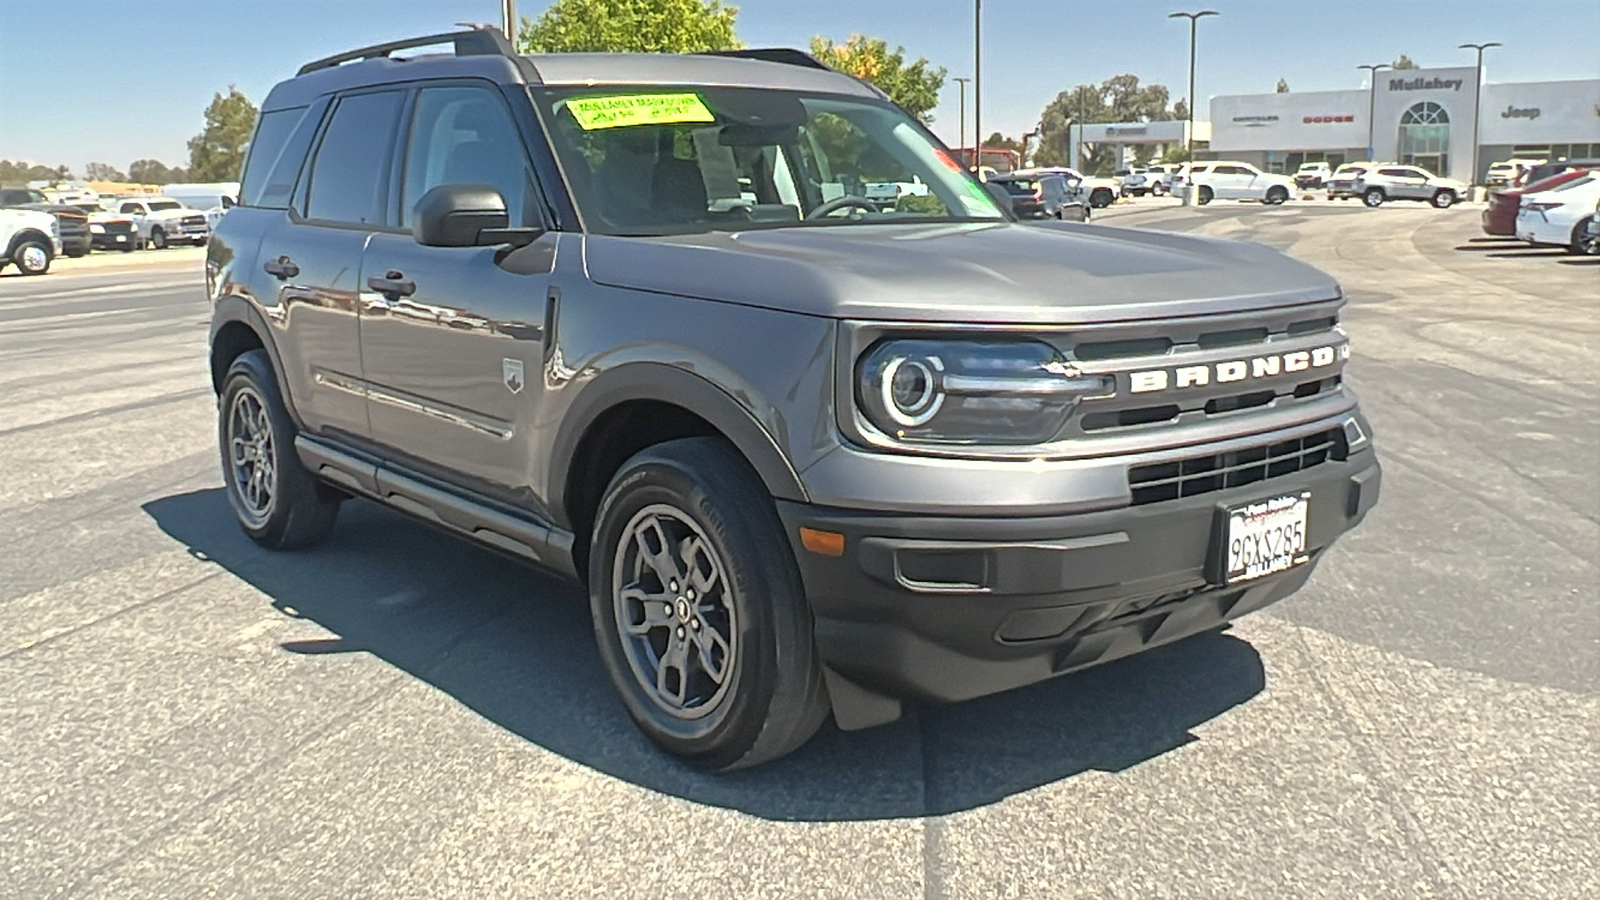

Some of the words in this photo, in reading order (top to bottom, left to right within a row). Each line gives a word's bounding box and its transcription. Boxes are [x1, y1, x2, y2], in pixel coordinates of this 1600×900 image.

[1389, 77, 1463, 92] Mullahey
[1303, 115, 1354, 124] DODGE
[1501, 105, 1541, 120] Jeep
[1130, 346, 1334, 393] BRONCO
[1231, 520, 1302, 572] 9GXS285
